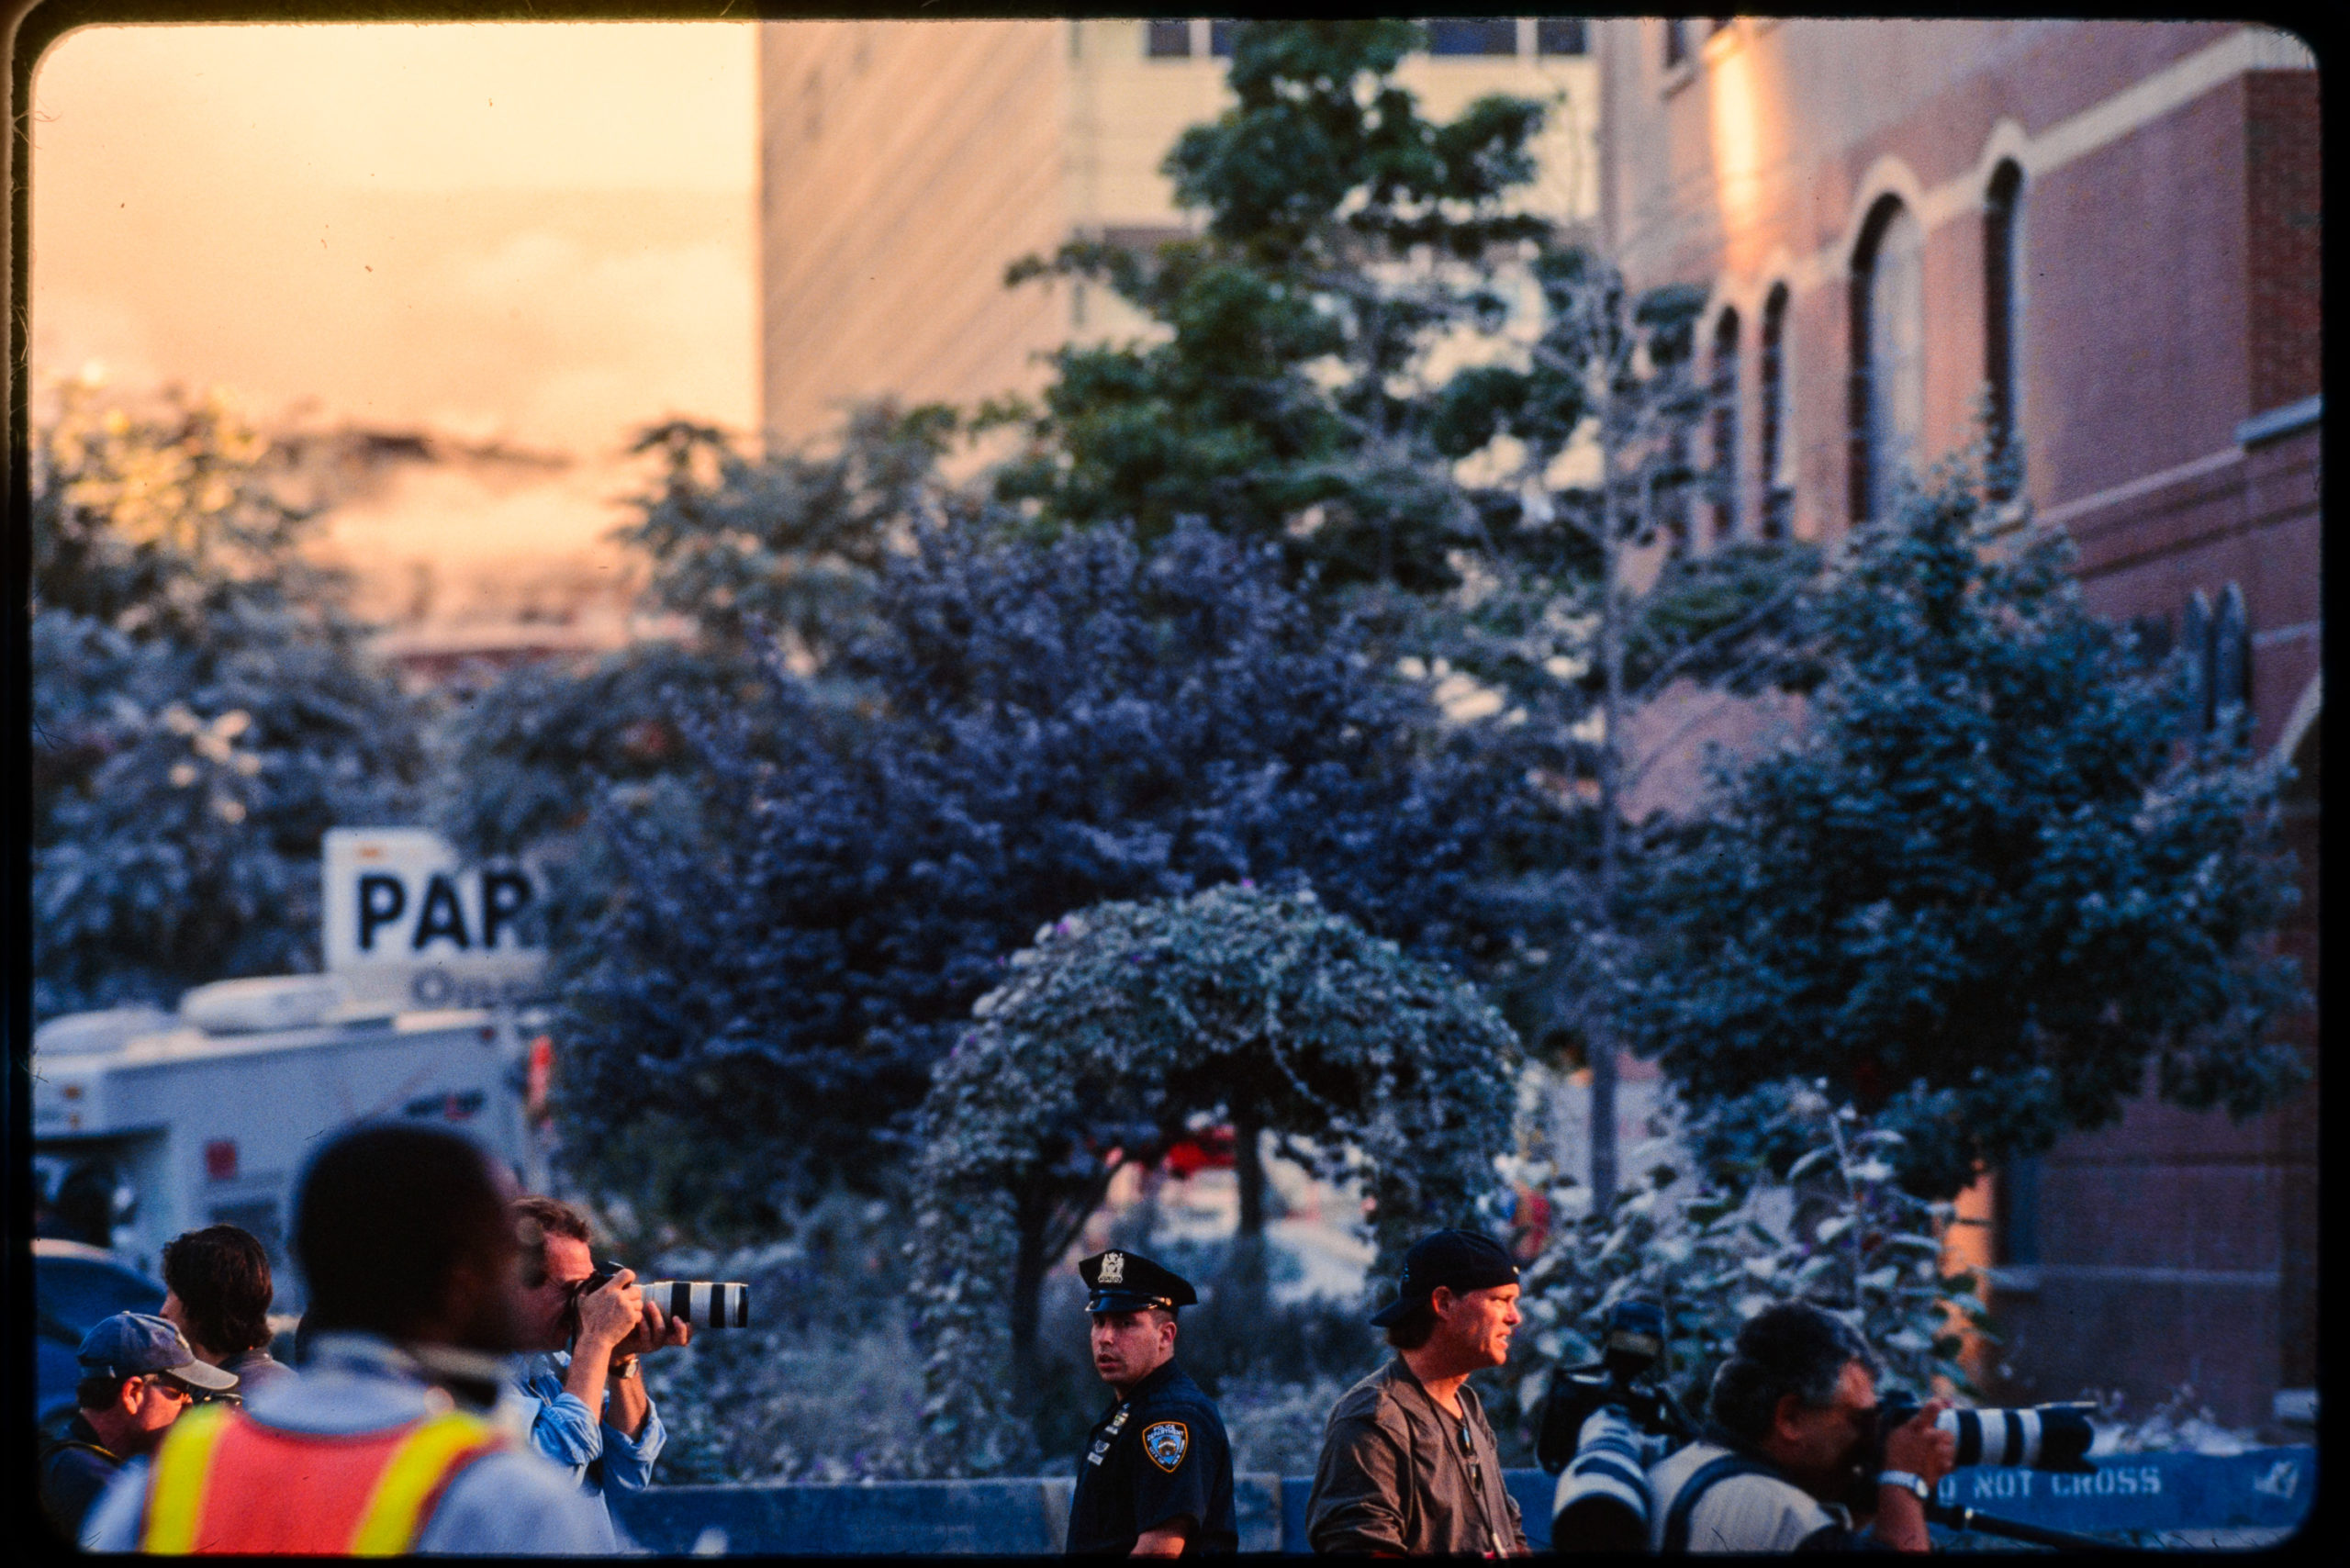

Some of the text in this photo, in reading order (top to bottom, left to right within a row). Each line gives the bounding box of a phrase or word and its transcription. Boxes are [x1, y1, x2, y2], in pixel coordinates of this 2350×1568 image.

[1147, 1428, 1184, 1441] DEPARTMENT
[1153, 1424, 1175, 1432] POLICE
[1974, 1470, 2033, 1498] NOT
[2051, 1467, 2162, 1495] CROSS
